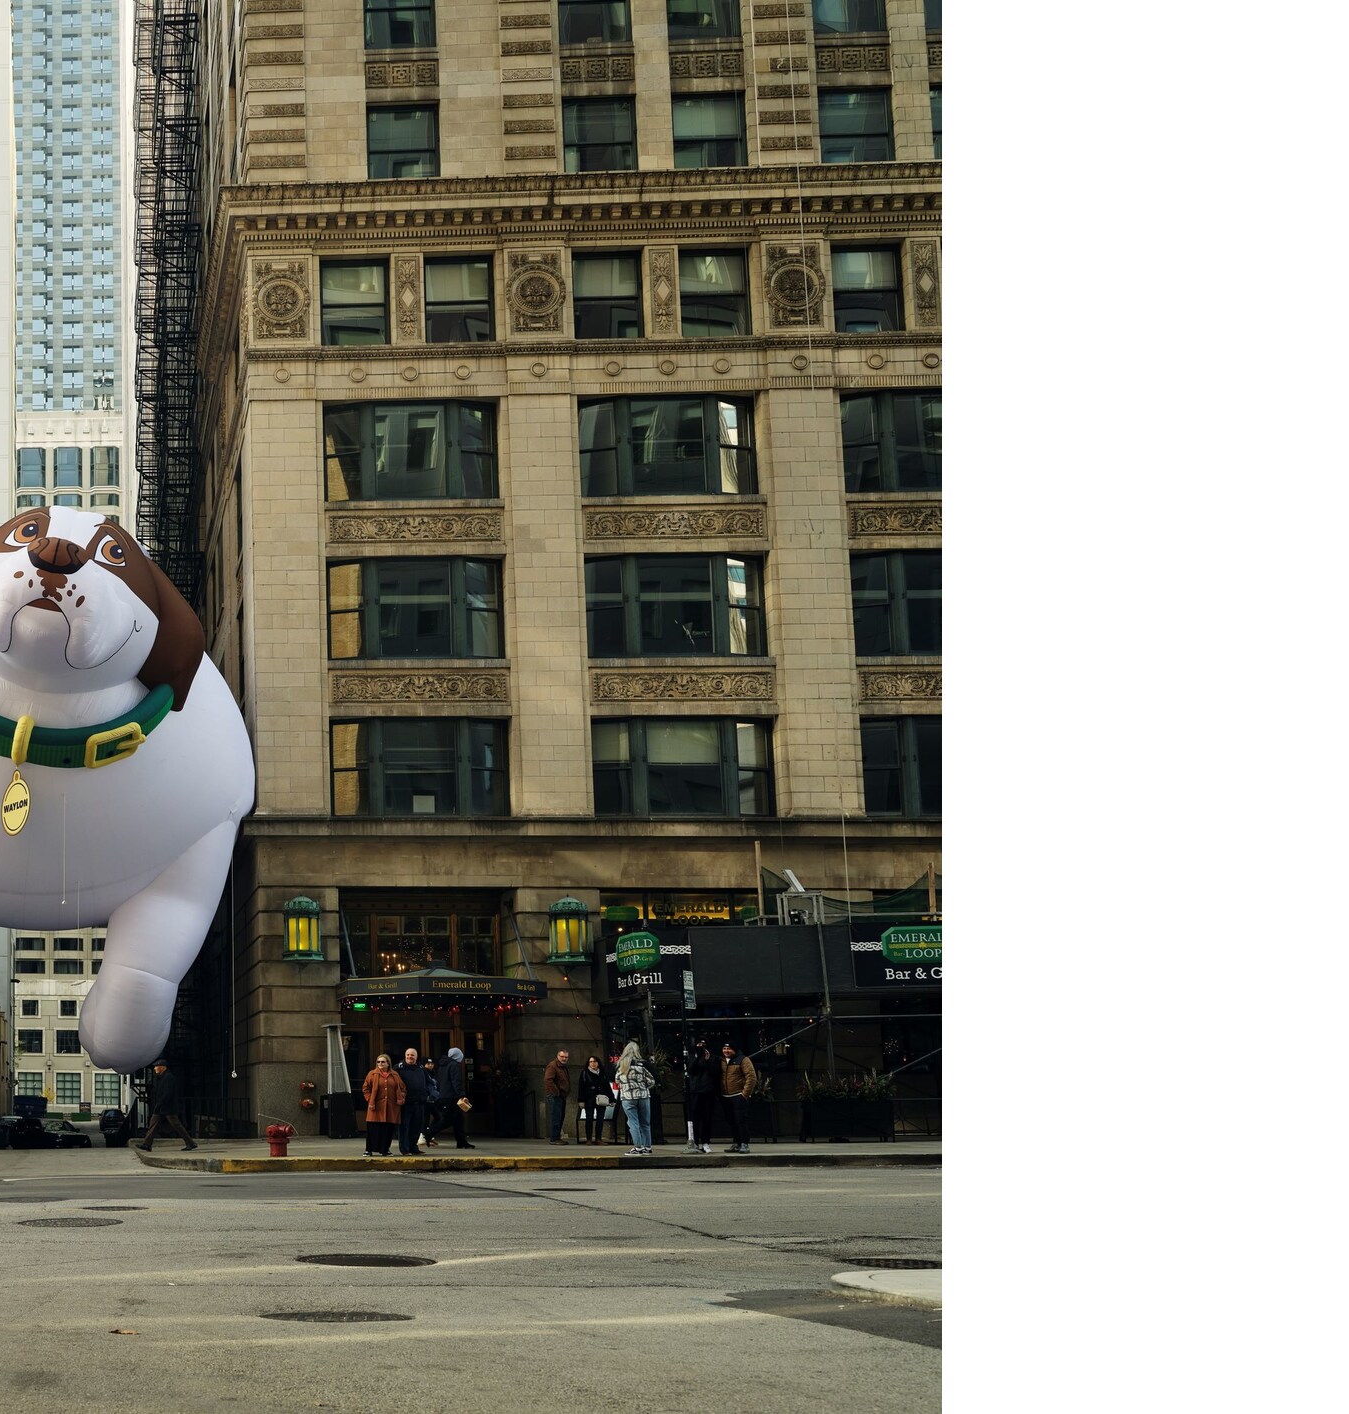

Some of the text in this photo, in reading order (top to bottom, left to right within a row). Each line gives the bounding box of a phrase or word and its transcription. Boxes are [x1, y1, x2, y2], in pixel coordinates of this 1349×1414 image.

[4, 799, 28, 813] WAYLON
[654, 903, 725, 913] EMERALD
[671, 915, 709, 925] LOOP
[618, 939, 653, 952] EMERALD
[905, 948, 942, 959] LOOP
[884, 967, 911, 980] Bar
[915, 967, 927, 979] &
[432, 980, 492, 992] Emerald Loop
[617, 972, 663, 989] Bar & Grill
